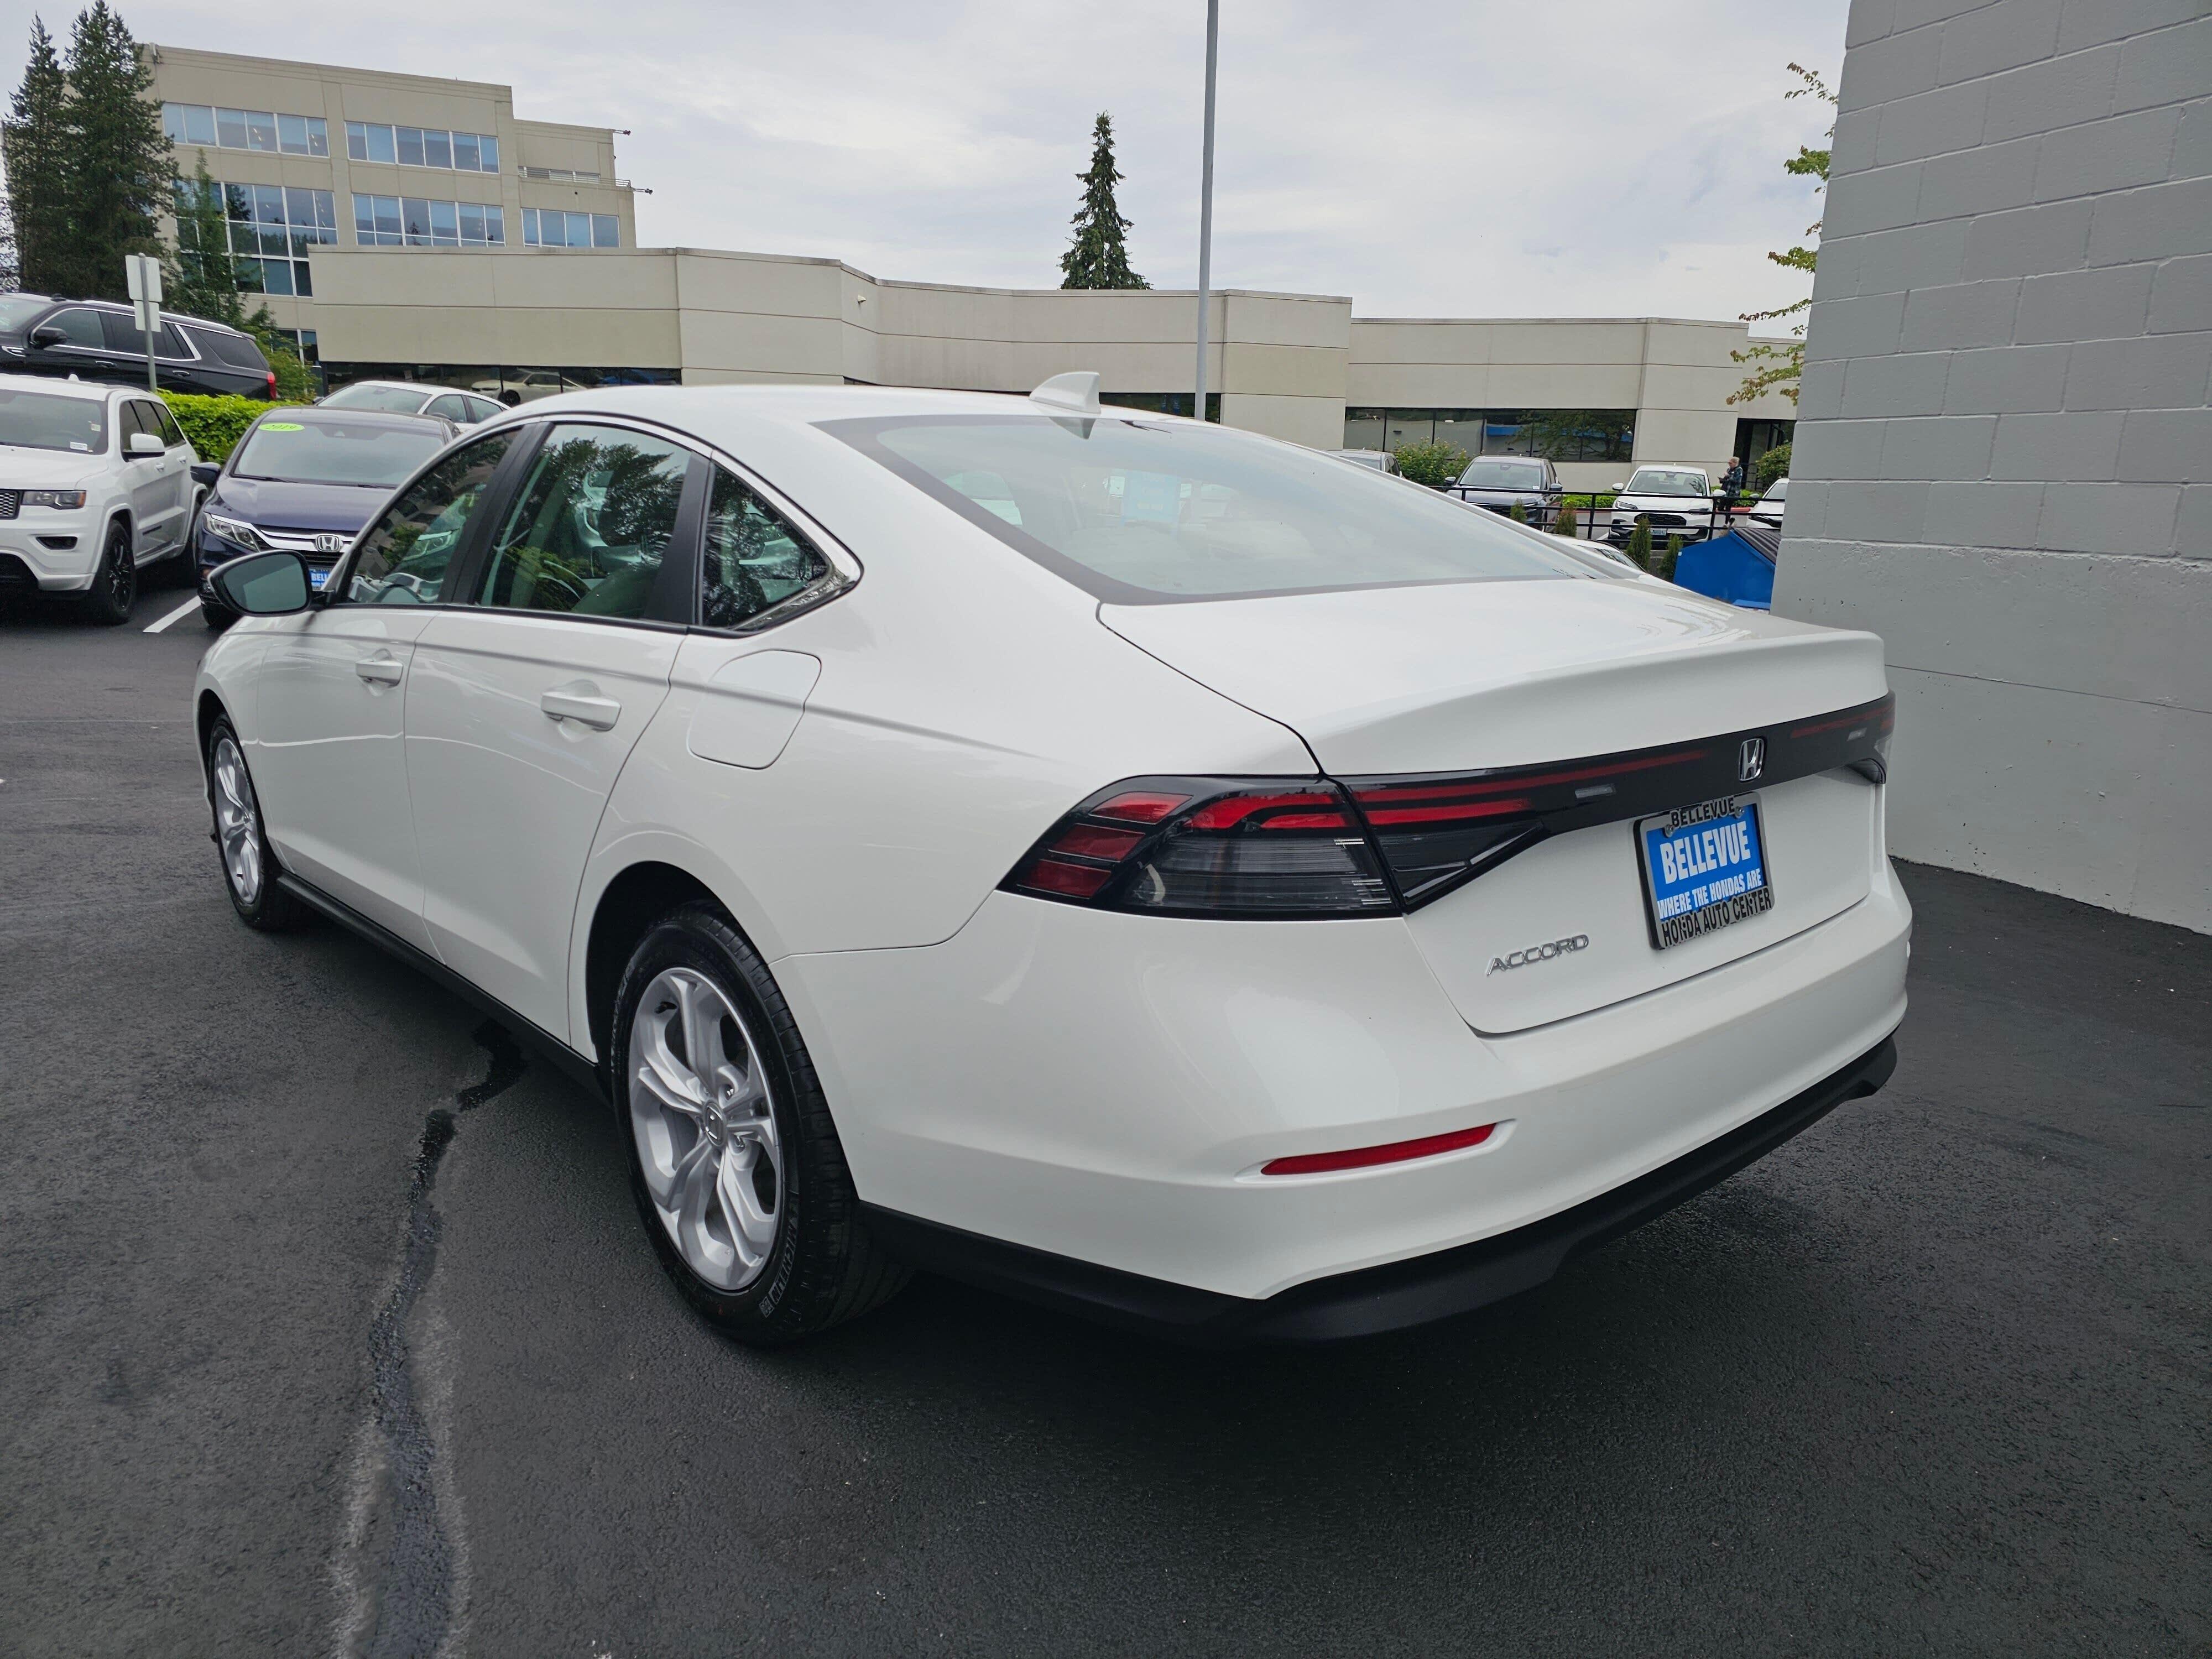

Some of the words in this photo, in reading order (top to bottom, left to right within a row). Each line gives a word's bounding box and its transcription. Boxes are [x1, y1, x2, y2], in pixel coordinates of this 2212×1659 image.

[1670, 797, 1735, 828] BELLEVUE
[1660, 821, 1751, 884] BELLEVUE
[1657, 891, 1692, 919] WHERE
[1692, 885, 1709, 906] THE
[1709, 873, 1745, 902] HONDAS
[1747, 868, 1762, 891] ARE
[1661, 915, 1702, 947] HONDA
[1704, 904, 1730, 934] AUTO
[1733, 889, 1772, 920] CENTER
[1485, 934, 1589, 977] ACCORD
